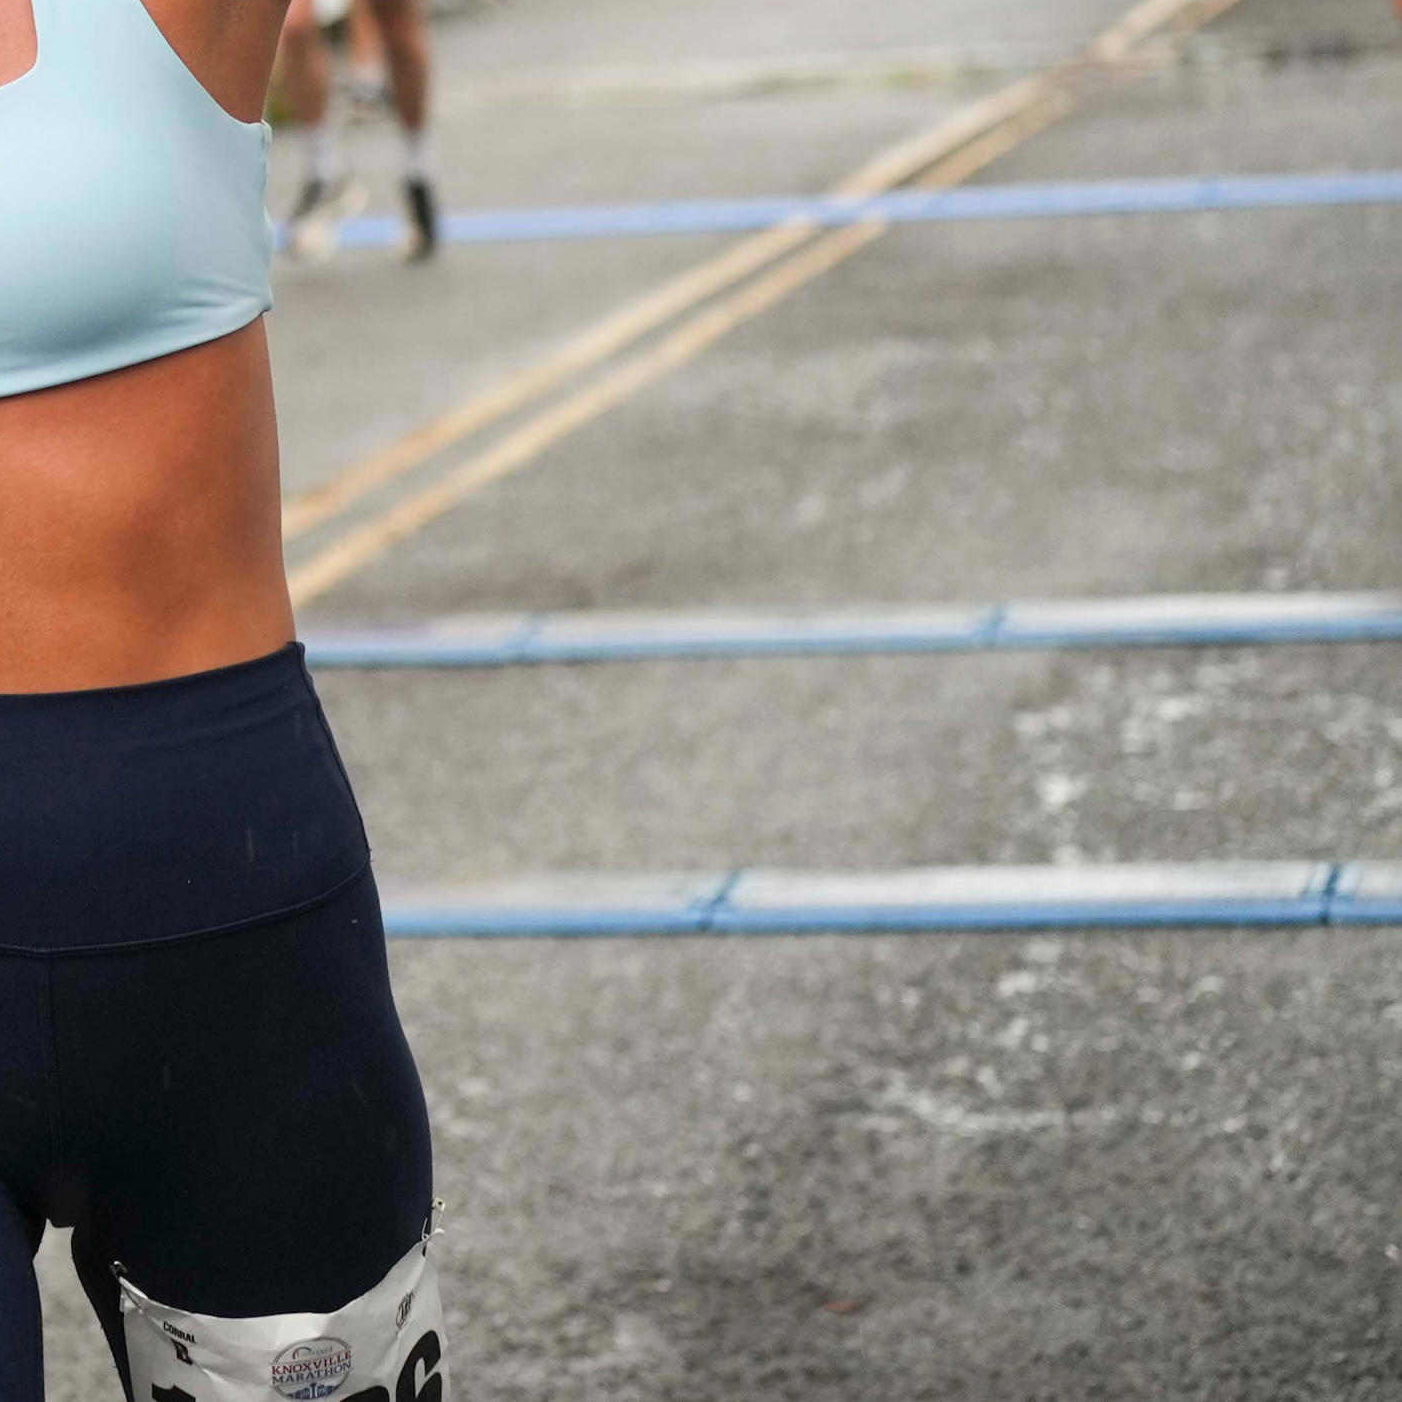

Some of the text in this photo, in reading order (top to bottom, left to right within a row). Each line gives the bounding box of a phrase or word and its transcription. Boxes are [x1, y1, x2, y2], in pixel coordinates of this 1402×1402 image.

[162, 1320, 198, 1345] CORRAL
[271, 1350, 352, 1375] KNOXVILLE
[272, 1360, 351, 1385] MARATHON
